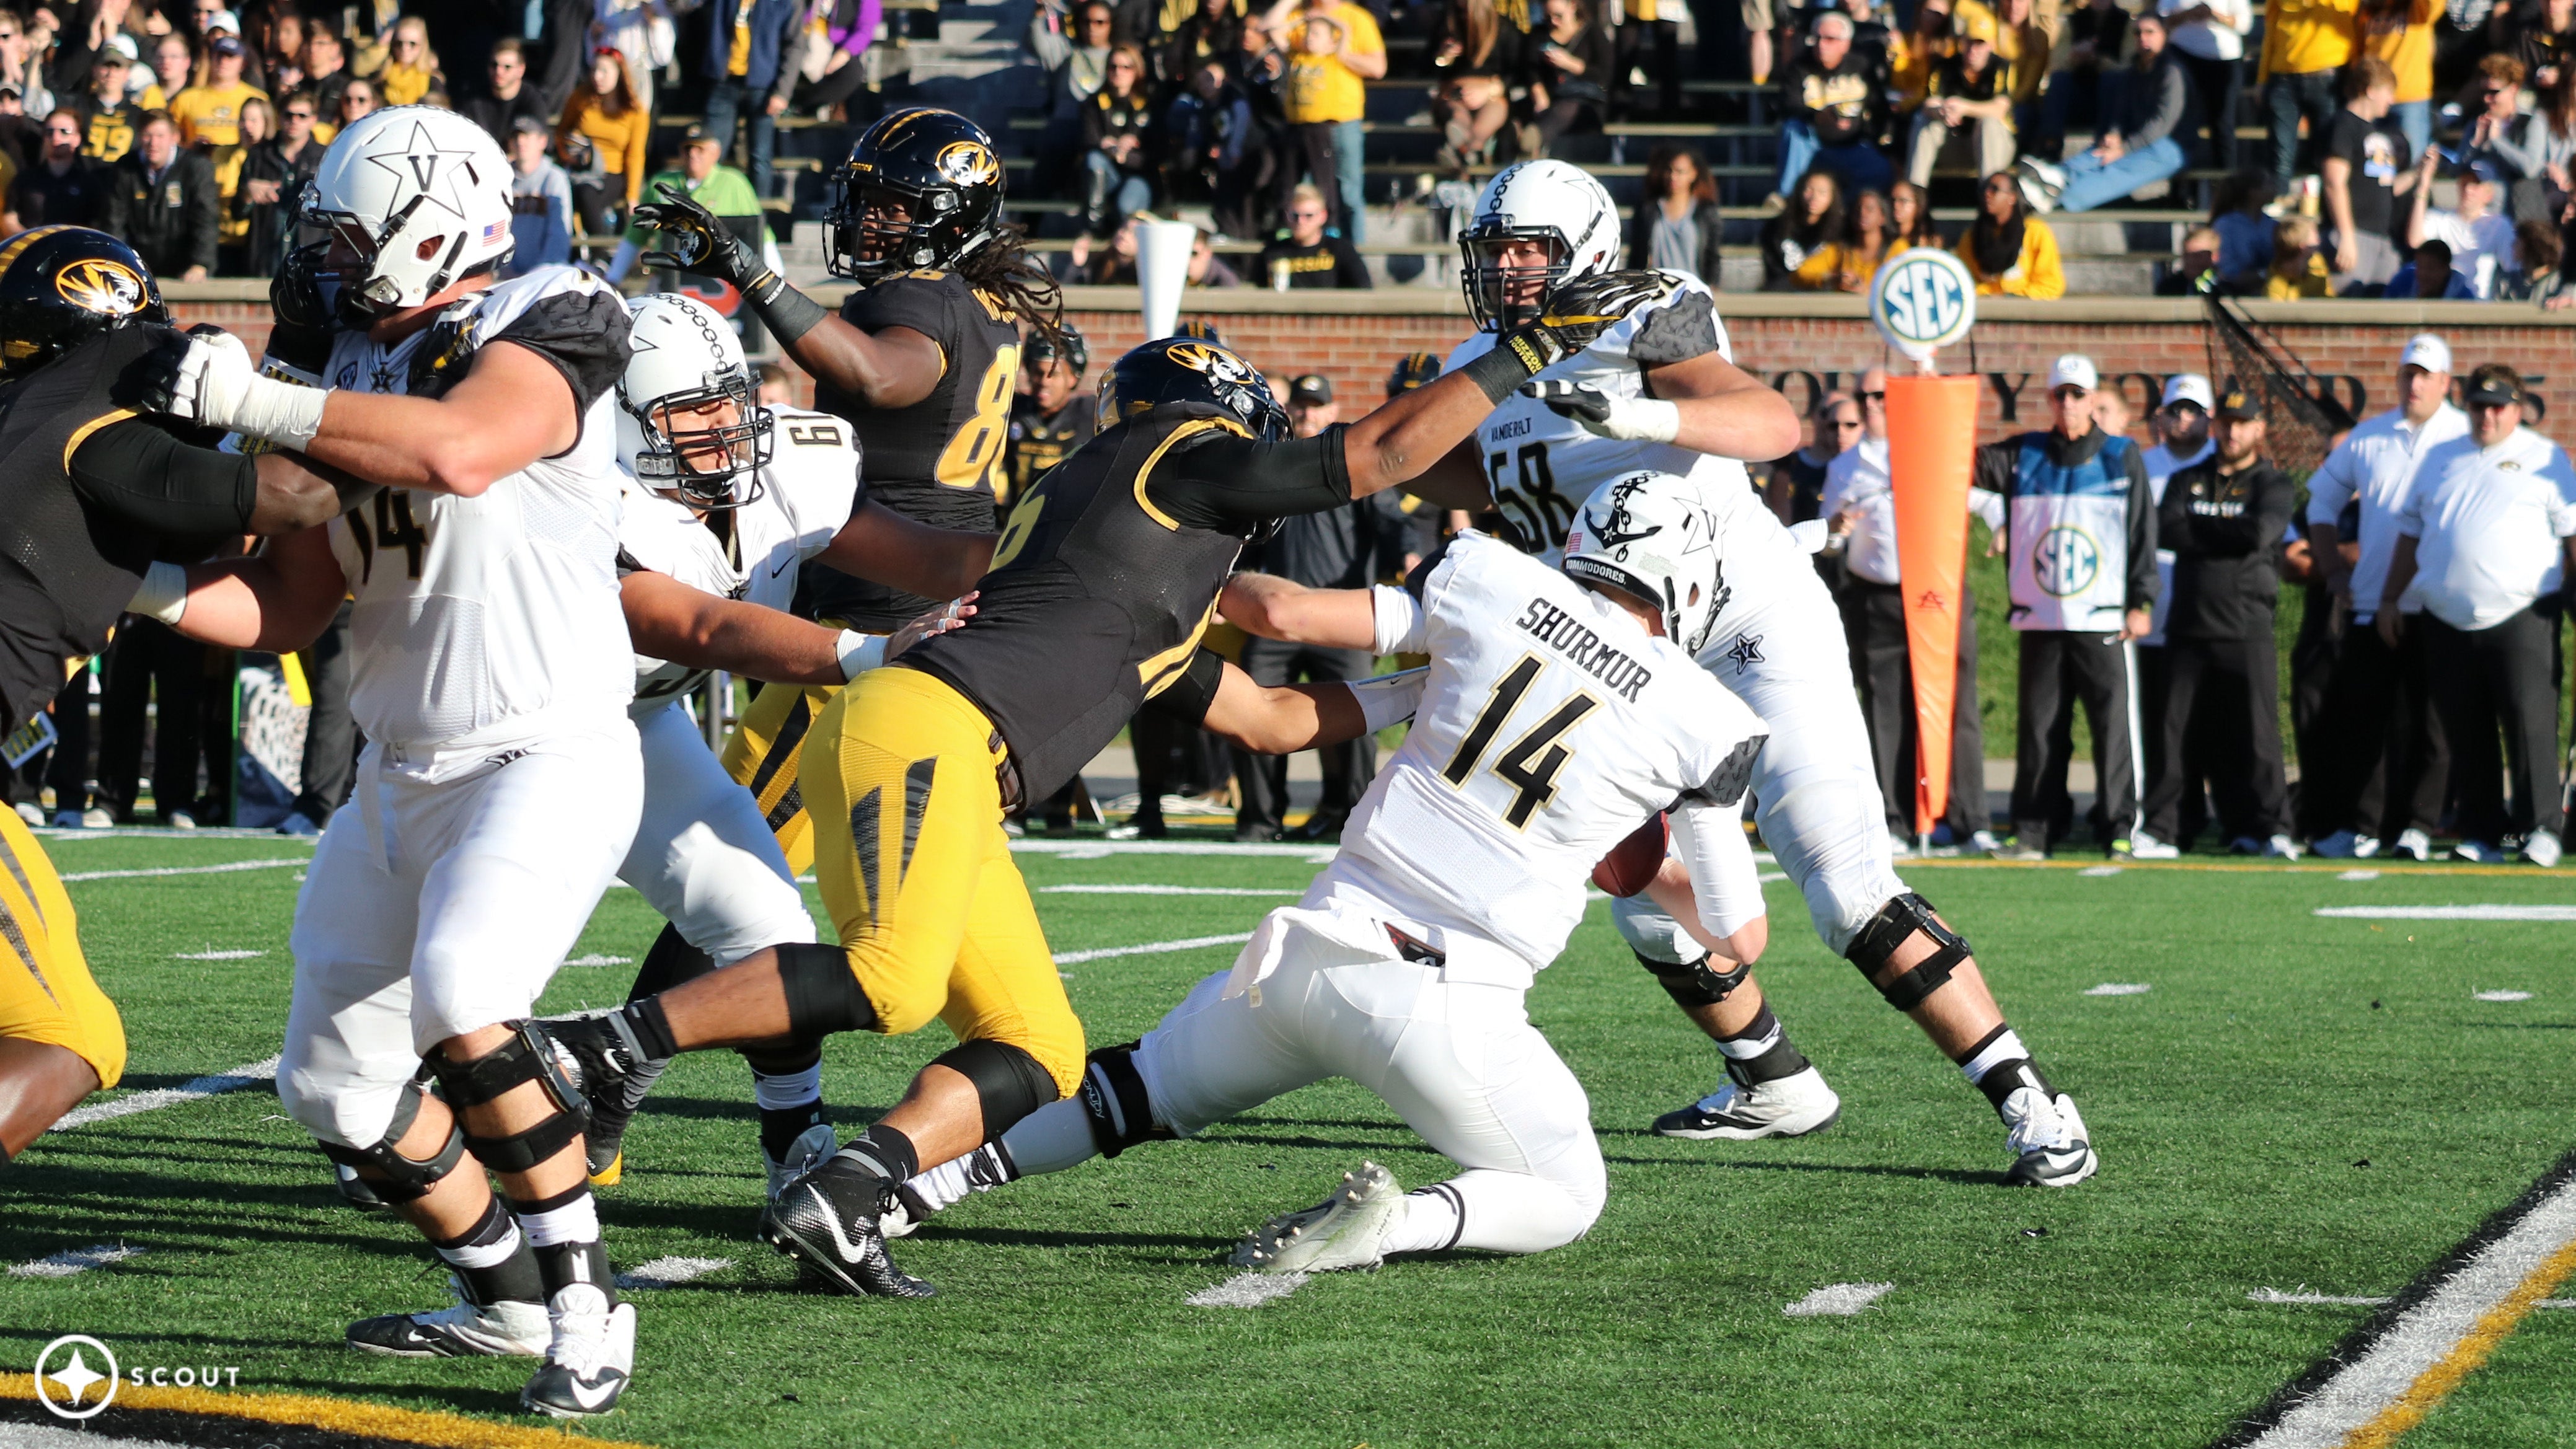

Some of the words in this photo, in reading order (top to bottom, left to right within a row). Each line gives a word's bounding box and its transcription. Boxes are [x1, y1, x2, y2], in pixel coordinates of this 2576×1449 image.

[407, 155, 438, 192] V
[1884, 261, 1962, 339] SEC
[1513, 335, 1543, 371] MIZZOU
[1489, 441, 1579, 554] 58
[1701, 508, 1718, 542] V
[2035, 528, 2097, 595] SEC
[1515, 597, 1652, 704] SHURMUR
[1437, 648, 1605, 835] 14
